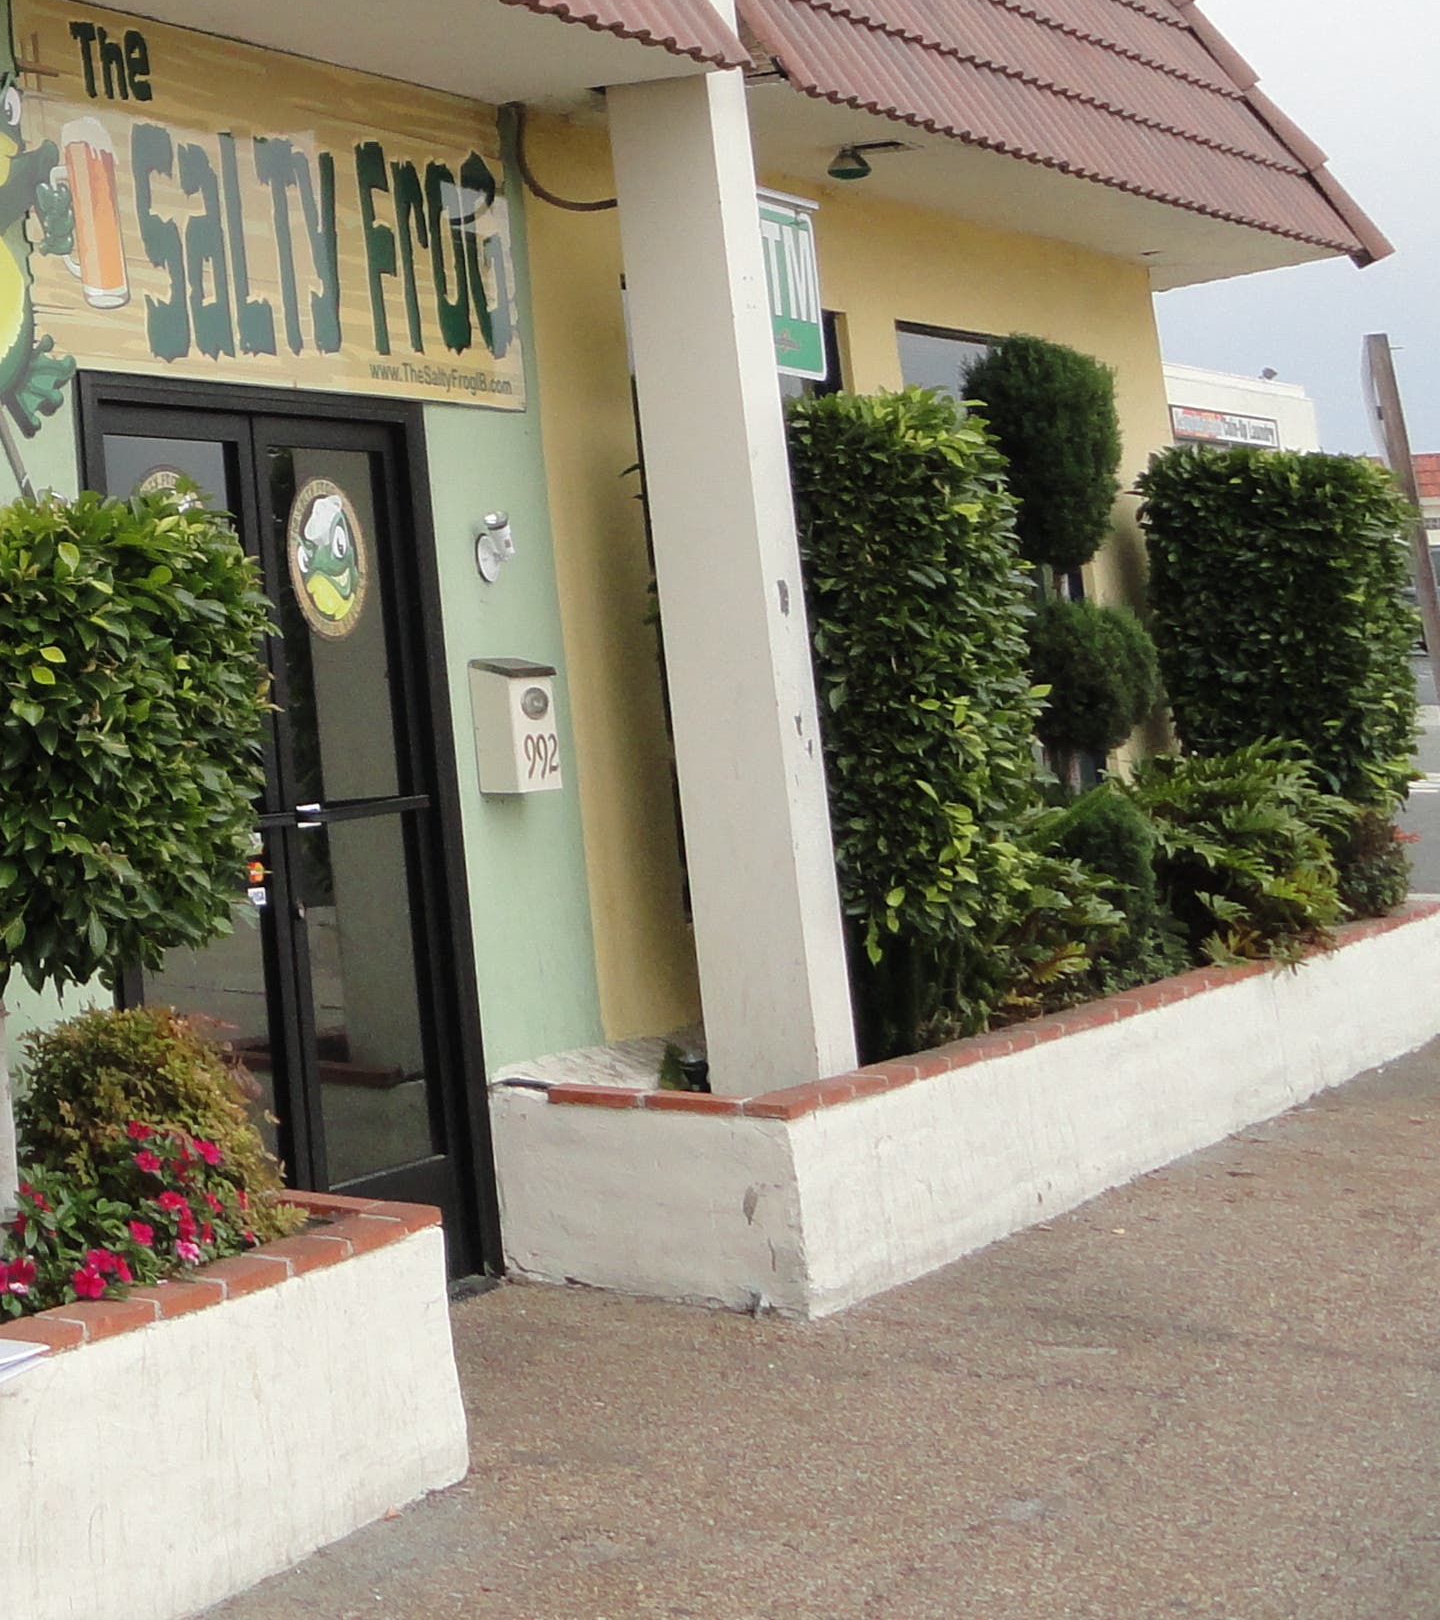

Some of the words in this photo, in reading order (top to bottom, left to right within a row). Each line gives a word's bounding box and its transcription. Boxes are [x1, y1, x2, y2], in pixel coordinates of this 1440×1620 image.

[70, 20, 152, 102] The
[369, 362, 513, 396] www.TheSaltyFrogIB.com
[523, 734, 559, 779] 992
